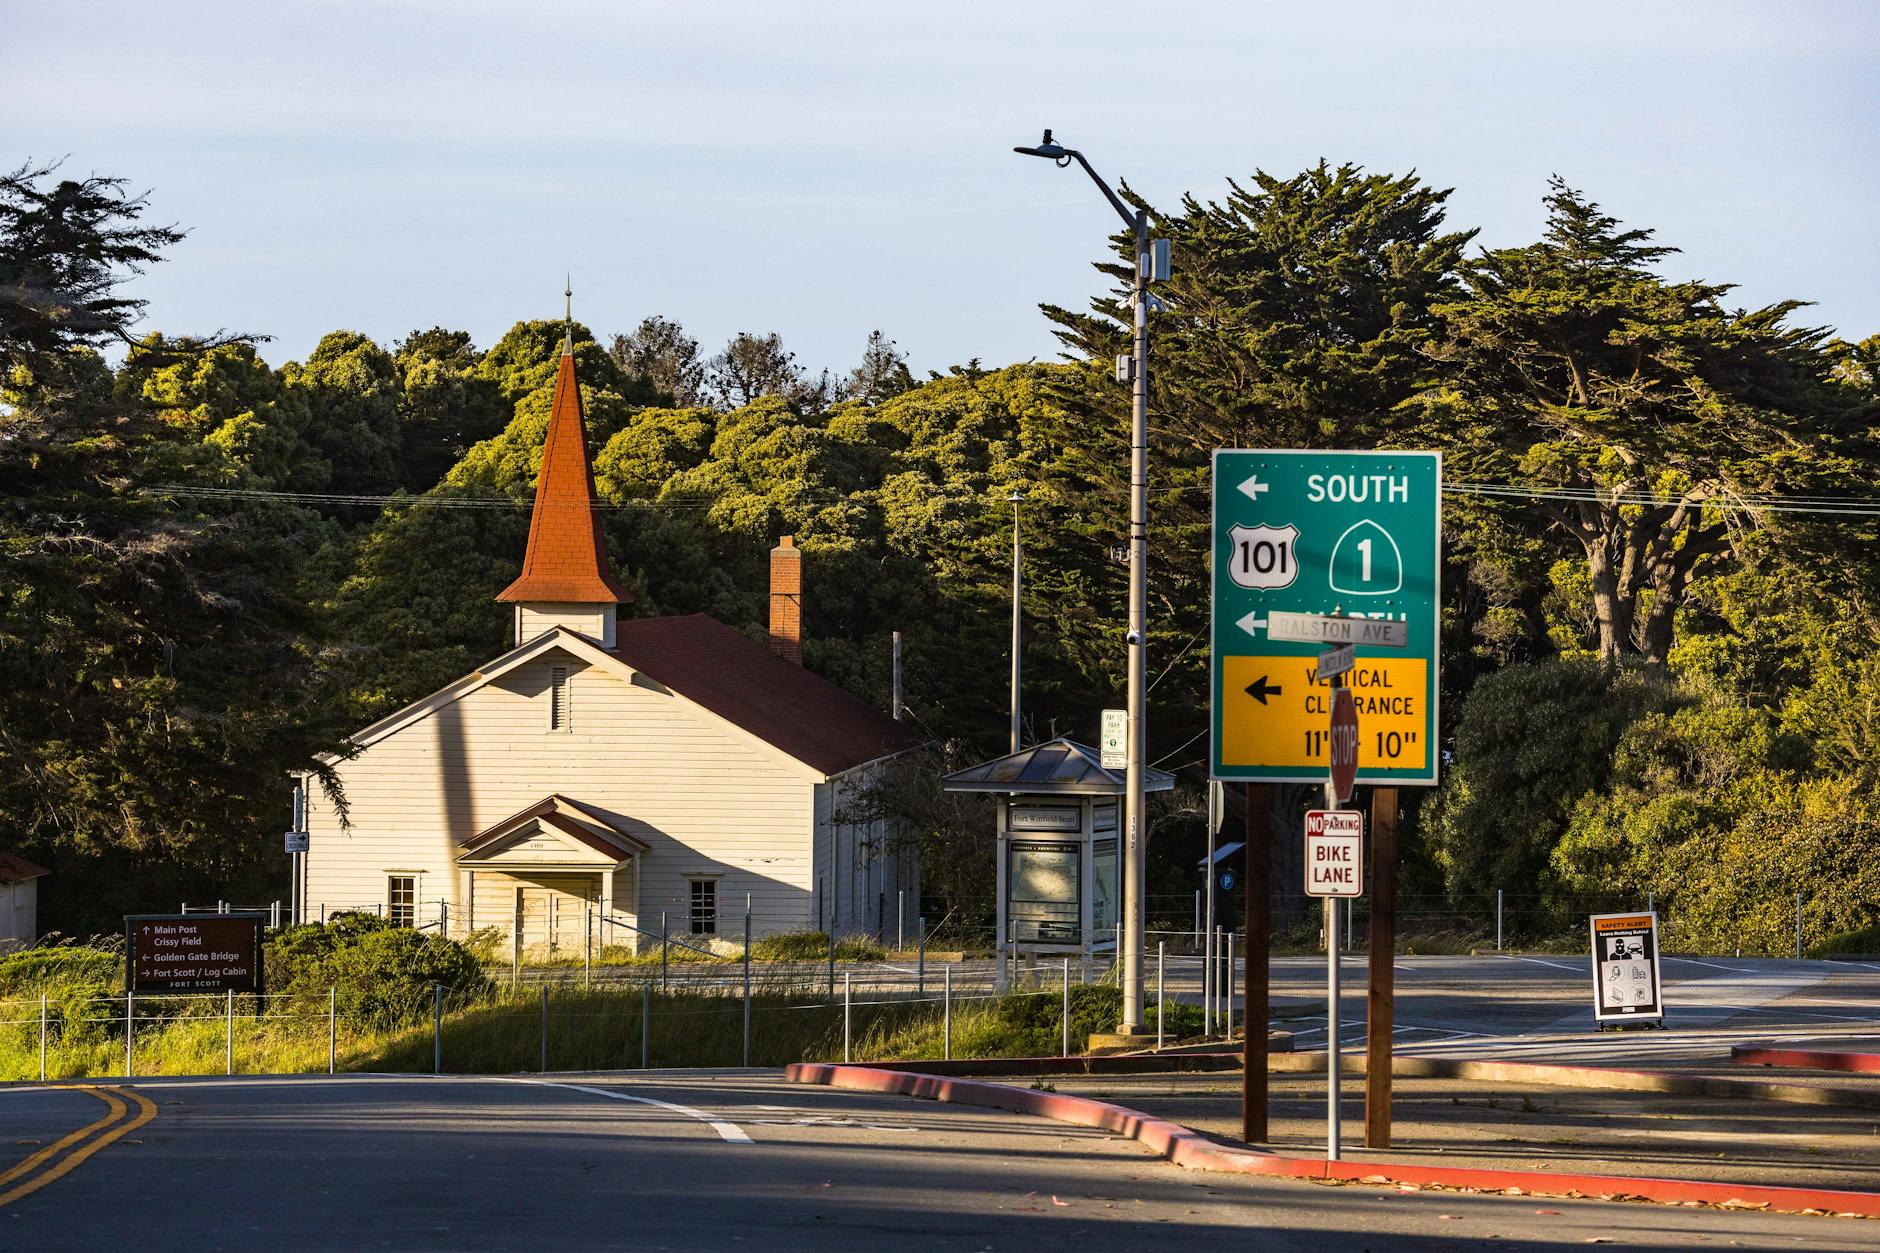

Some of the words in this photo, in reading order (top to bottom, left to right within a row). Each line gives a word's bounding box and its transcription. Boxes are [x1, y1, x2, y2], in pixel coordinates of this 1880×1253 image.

[1307, 474, 1408, 503] SOUTH
[1240, 541, 1287, 573] 101
[1357, 539, 1371, 581] 1
[1280, 618, 1351, 639] RALSTON
[1362, 624, 1397, 642] AVE.
[1306, 669, 1393, 687] VTICAL
[1305, 696, 1413, 715] CLRANCE
[1331, 725, 1357, 766] STOP
[1376, 731, 1416, 758] 10"
[1058, 815, 1075, 823] Scott
[1308, 816, 1324, 832] NO
[1324, 819, 1359, 831] PARKING
[1316, 845, 1351, 862] BIKE
[1313, 867, 1353, 883] LANE
[154, 926, 176, 934] Main
[178, 925, 197, 934] Post
[154, 938, 180, 948] Crissy
[181, 937, 202, 946] Field
[153, 953, 185, 962] Golden
[187, 952, 209, 961] Gate
[210, 951, 240, 962] Bridge
[153, 969, 171, 977] Fort
[173, 968, 196, 977] Scott
[196, 968, 202, 978] /
[204, 968, 221, 978] Log
[222, 967, 247, 976] Cabin
